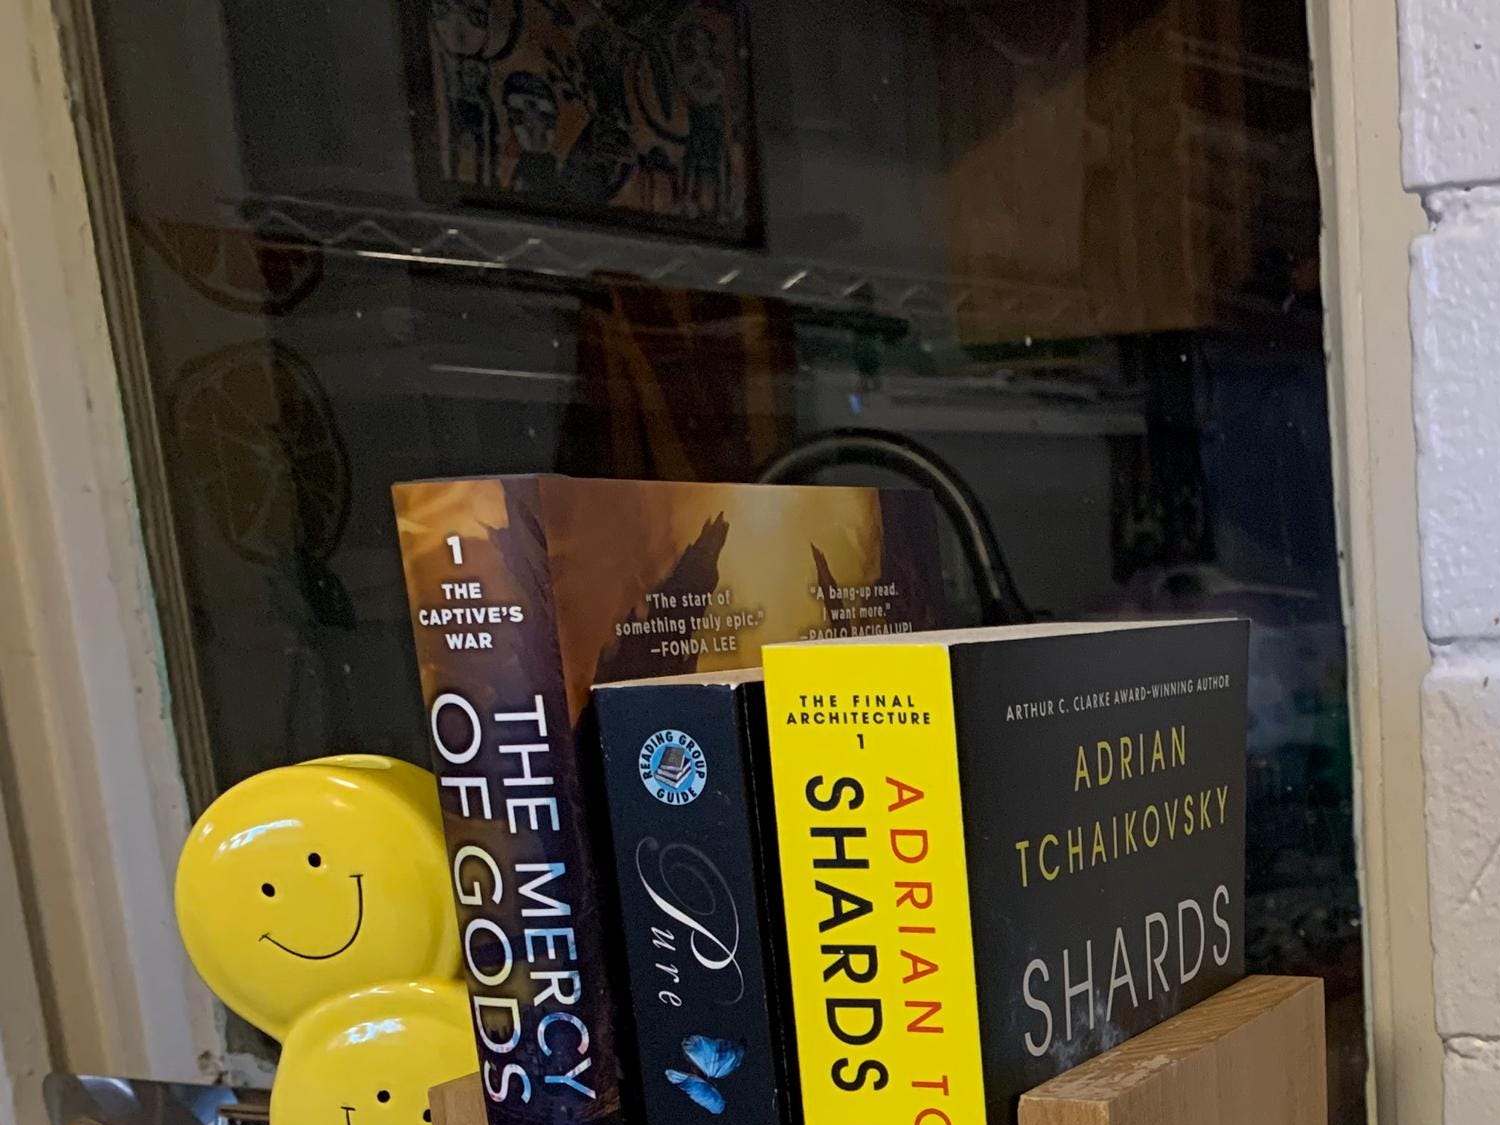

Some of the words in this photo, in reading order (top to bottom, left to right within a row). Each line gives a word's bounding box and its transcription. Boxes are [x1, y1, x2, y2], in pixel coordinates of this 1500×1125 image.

[446, 535, 464, 566] 1
[441, 582, 483, 601] THE
[681, 592, 712, 608] start
[717, 590, 731, 606] of
[874, 582, 900, 598] read.
[418, 605, 525, 627] CAPTIVE'S
[615, 616, 686, 637] something
[690, 613, 722, 632] truly
[831, 605, 857, 621] want
[445, 632, 494, 651] WAR
[713, 635, 738, 652] LEE
[799, 695, 837, 708] THE
[852, 694, 915, 708] FINAL
[1006, 700, 1055, 722] ARTHUR
[1058, 698, 1070, 714] C.
[1073, 691, 1111, 712] CLARKE
[1113, 679, 1194, 705] AWARD-WINNING
[1196, 674, 1230, 691] AUTHOR
[786, 711, 931, 725] ARCHITECTURE
[430, 692, 493, 821] OF
[641, 731, 673, 780] READING
[678, 734, 706, 780] GROUP
[856, 733, 865, 750] 1
[494, 694, 561, 834] THE
[1074, 725, 1187, 792] ADRIAN
[656, 786, 698, 804] GUIDE
[1015, 785, 1229, 888] TCHAIKOVSKY
[885, 775, 945, 1035] ADRIAN
[635, 836, 745, 1006] Pure
[805, 775, 889, 1092] SHARDS
[453, 844, 532, 1105] GODS
[514, 861, 597, 1100] MERCY
[1022, 884, 1231, 1057] SHARDS
